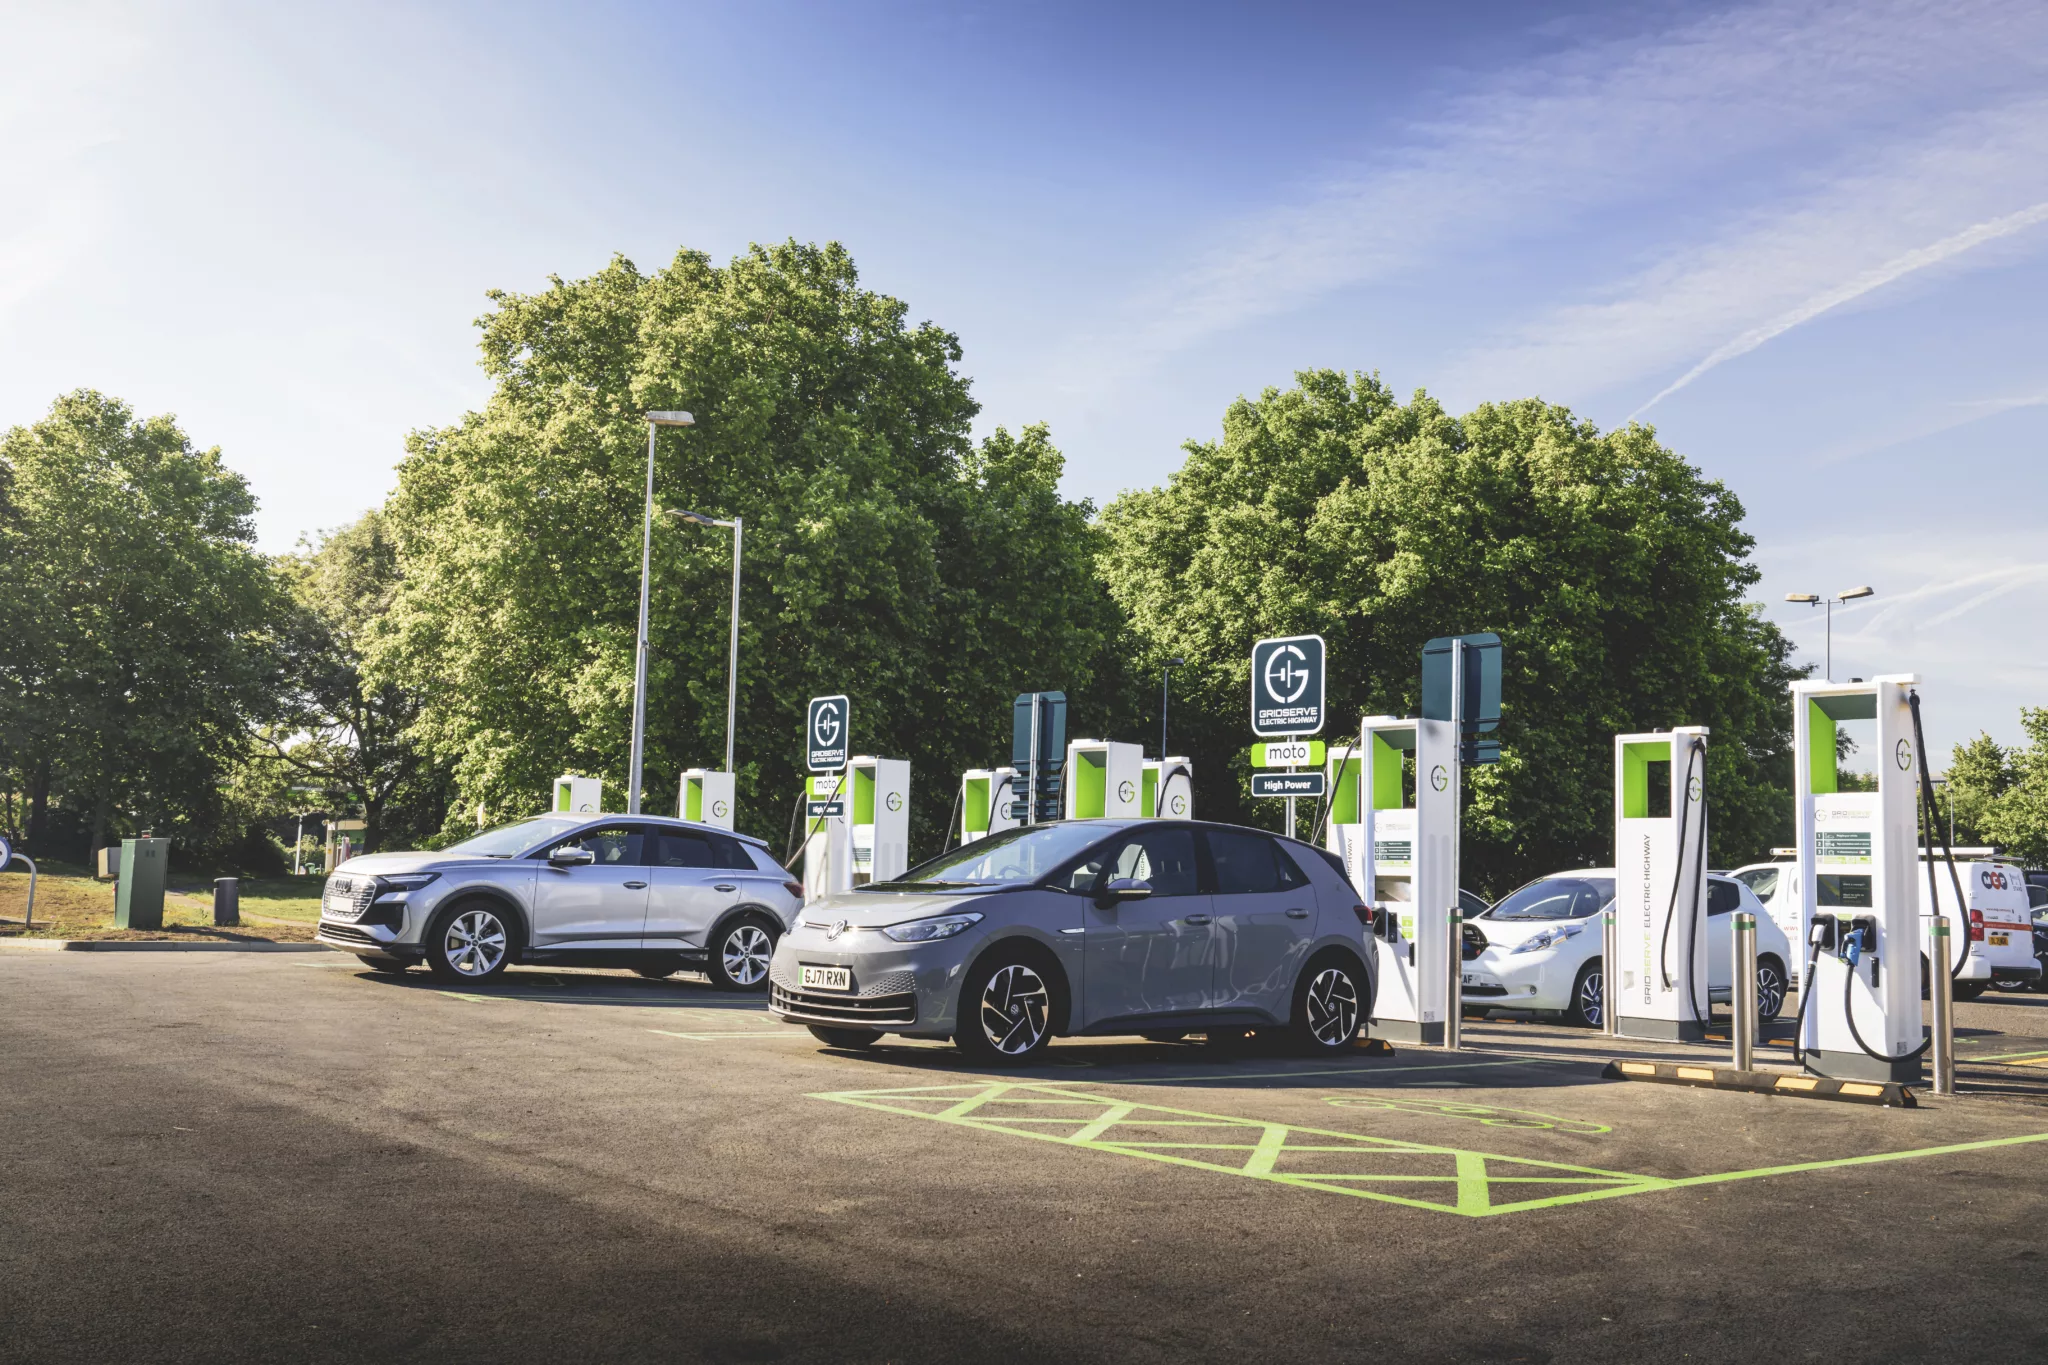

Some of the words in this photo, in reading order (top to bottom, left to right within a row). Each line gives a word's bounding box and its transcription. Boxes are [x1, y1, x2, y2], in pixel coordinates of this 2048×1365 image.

[1259, 707, 1318, 718] GRIDSERVE
[1259, 716, 1287, 726] ELECTRIC
[1287, 715, 1318, 725] HIGHWAY
[1269, 744, 1306, 760] moto
[816, 778, 837, 790] moto
[1264, 780, 1284, 792] High
[1284, 780, 1312, 790] Power
[1643, 834, 1651, 881] HIGHWAY
[1983, 876, 2005, 886] MCP
[1643, 882, 1651, 928] ELECTRIC
[1643, 932, 1652, 1005] GRIDSERVE
[805, 969, 825, 984] GJ71
[827, 971, 846, 986] RXN
[1462, 974, 1473, 984] AF
